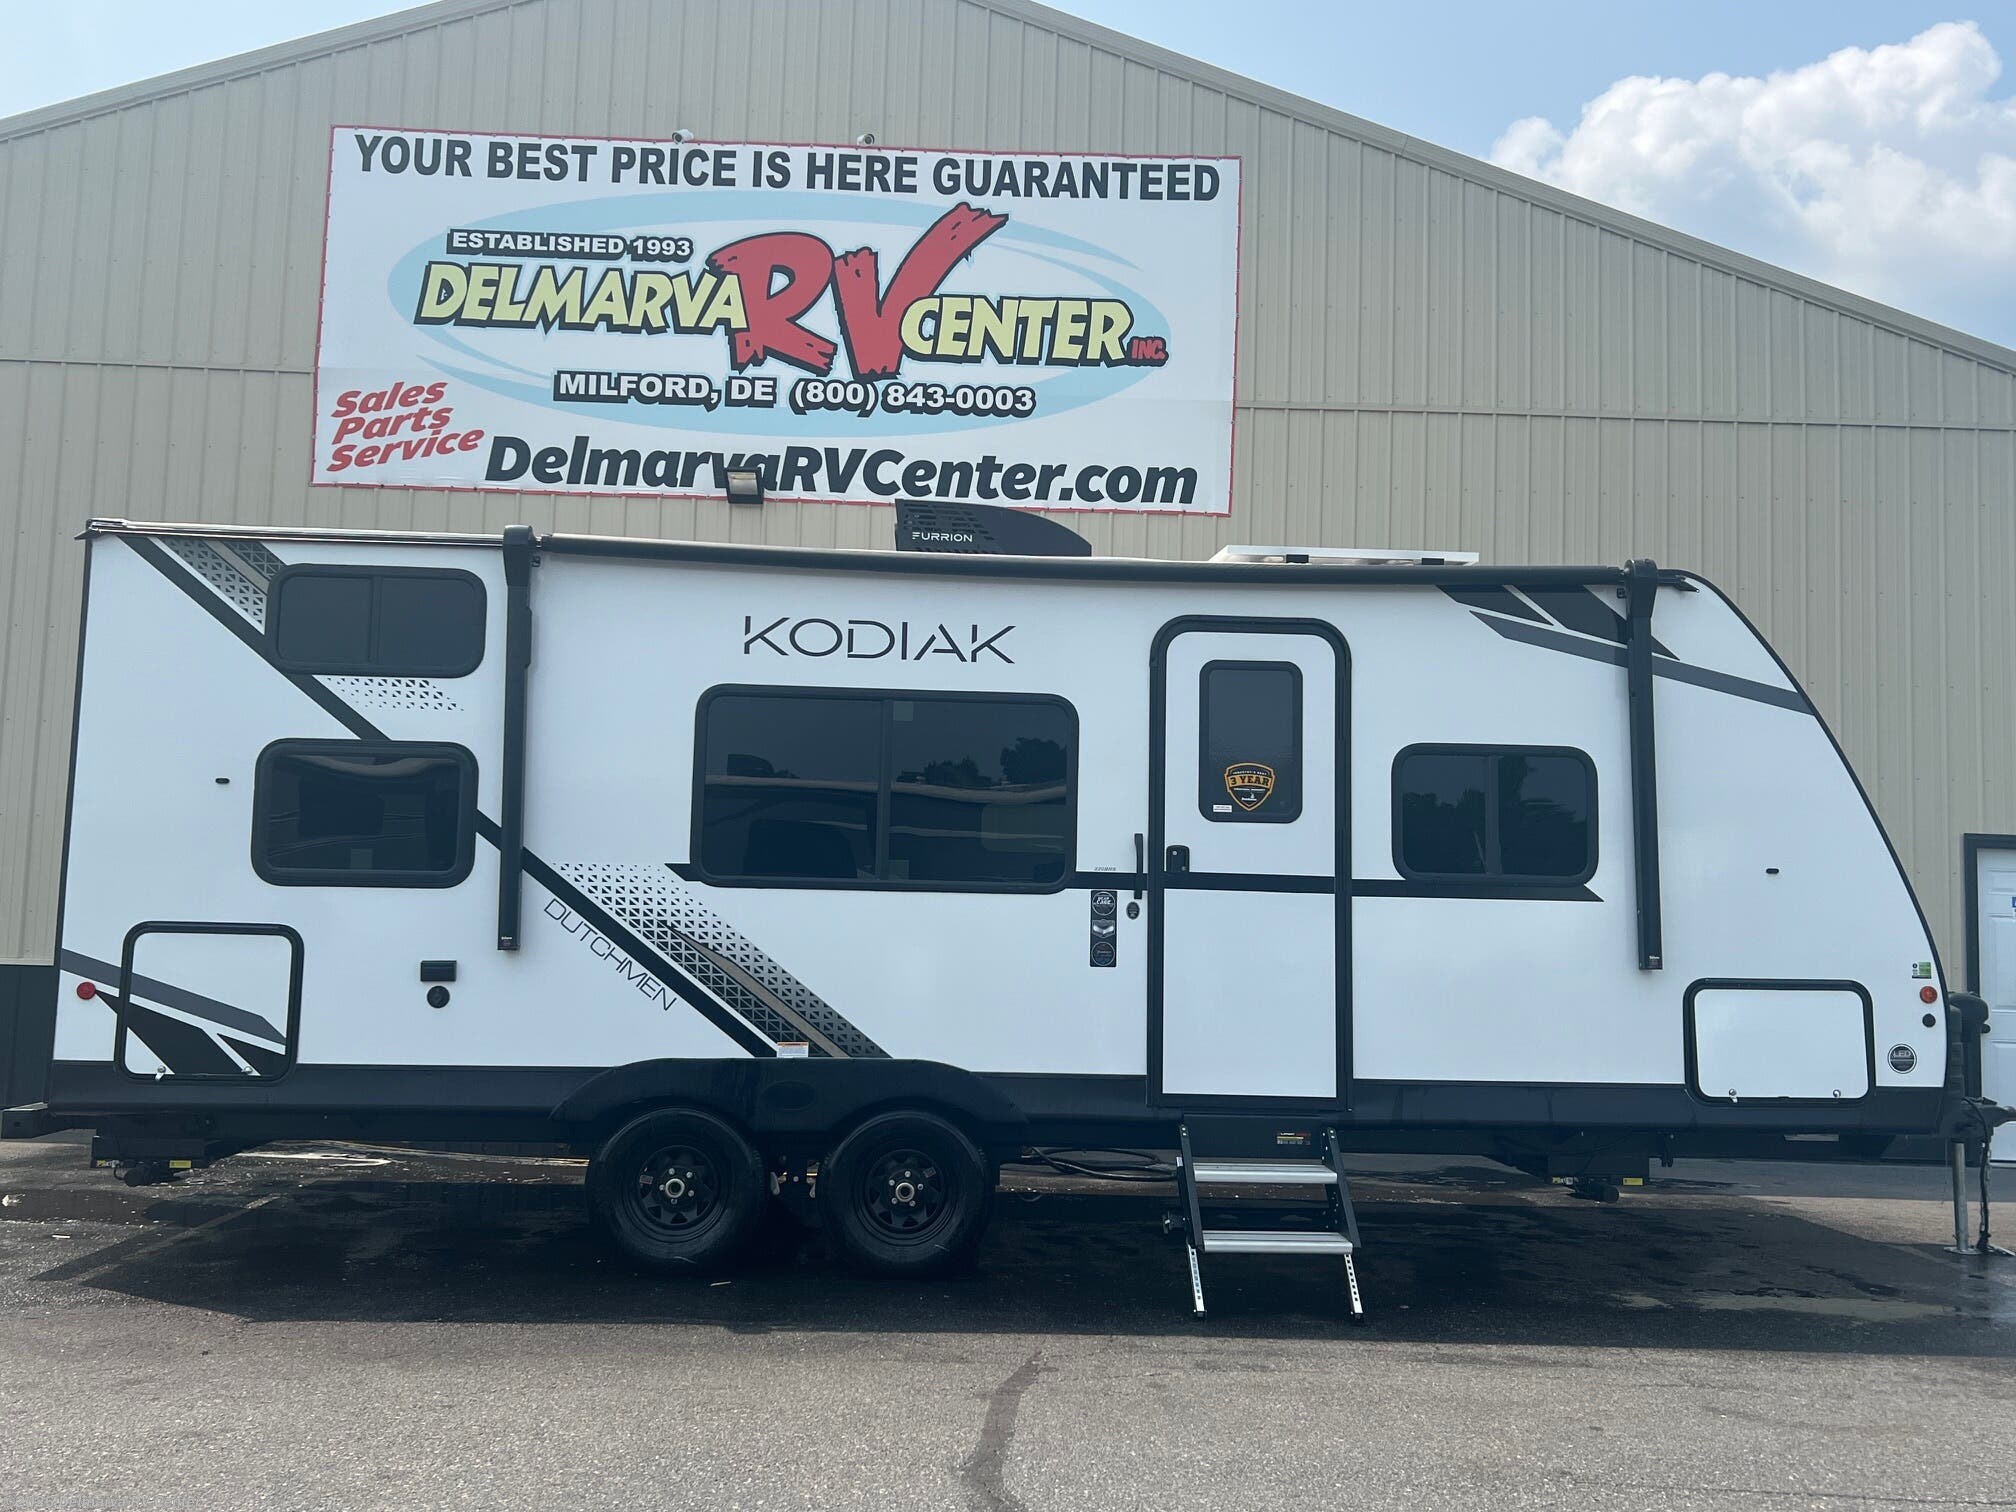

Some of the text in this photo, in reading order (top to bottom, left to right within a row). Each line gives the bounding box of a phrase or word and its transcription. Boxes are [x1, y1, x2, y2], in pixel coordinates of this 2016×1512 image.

[354, 134, 1220, 201] YOUR BEST PRICE IS HERE GUARANTEED
[452, 232, 692, 256] ESTABLISHED 1993
[415, 261, 748, 335] DELMARVA
[706, 202, 1009, 380] RV
[900, 294, 1134, 367] CENTER
[331, 381, 449, 418] Sales
[558, 373, 1034, 411] MILFORD, DE (800) 843-0003
[331, 404, 453, 446] Parts
[326, 427, 485, 473] Service
[485, 435, 1198, 504] DelmarvaRVCenter.com
[911, 531, 973, 543] FURRION
[743, 615, 1017, 665] KODIAK
[1230, 775, 1270, 787] 3 YEAR
[544, 898, 677, 1011] DUTCHMEN
